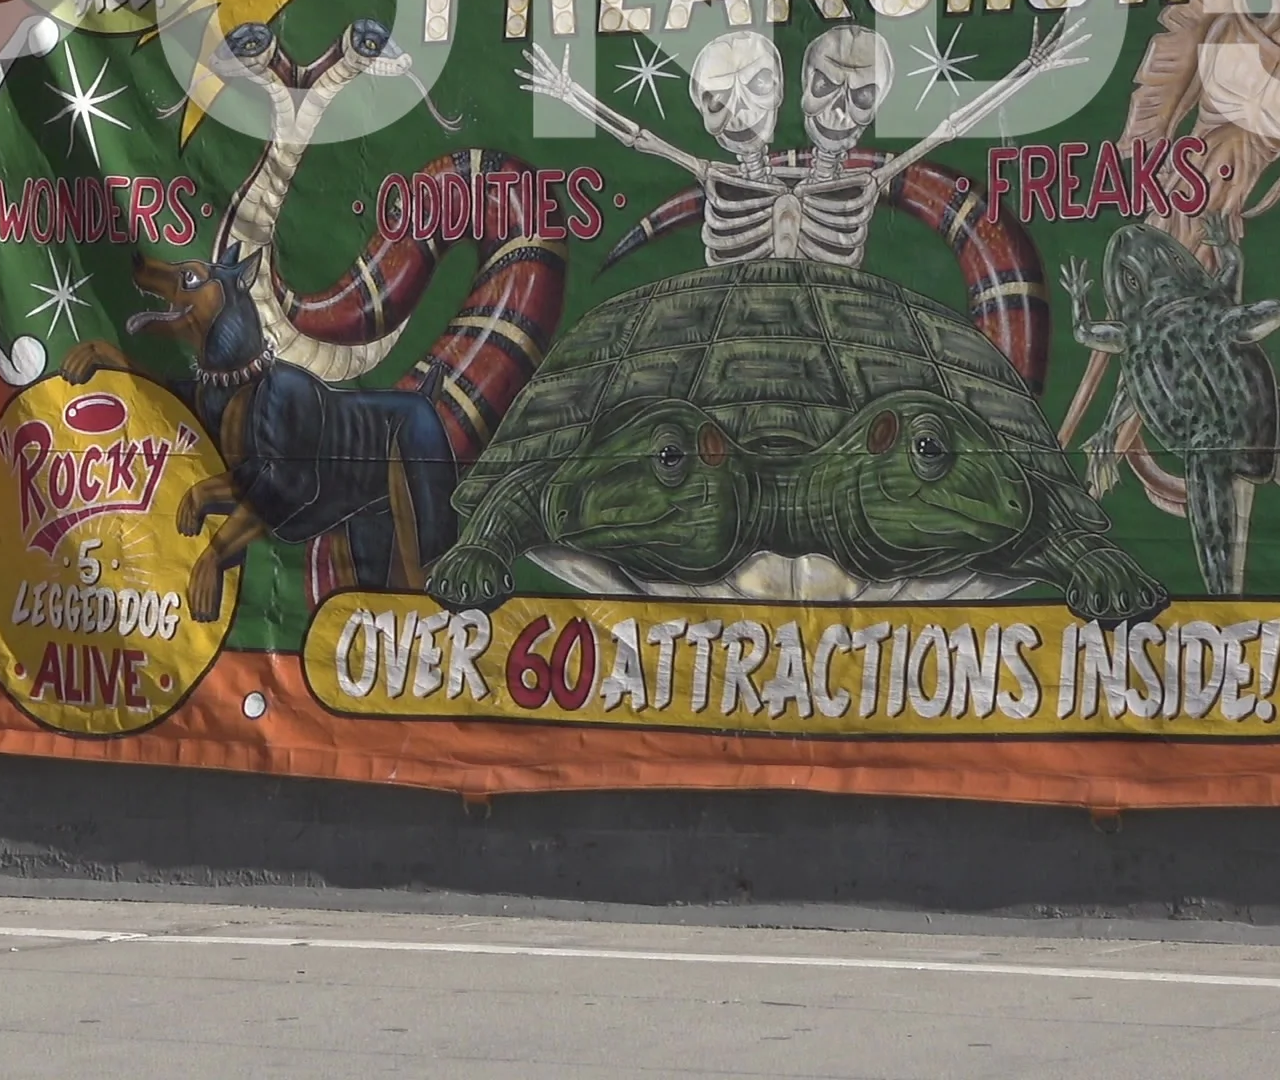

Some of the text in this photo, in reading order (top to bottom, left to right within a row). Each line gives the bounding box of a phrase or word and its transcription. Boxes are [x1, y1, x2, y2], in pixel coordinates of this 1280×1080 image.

[376, 166, 604, 242] ODDITIES
[986, 136, 1208, 222] FREAKS
[77, 538, 103, 584] 5
[12, 581, 181, 640] LEGGED DOG
[30, 641, 150, 713] ALIVE
[335, 608, 492, 700] OVER
[505, 614, 602, 711] 60
[600, 617, 1042, 719] ATTRACTIONS
